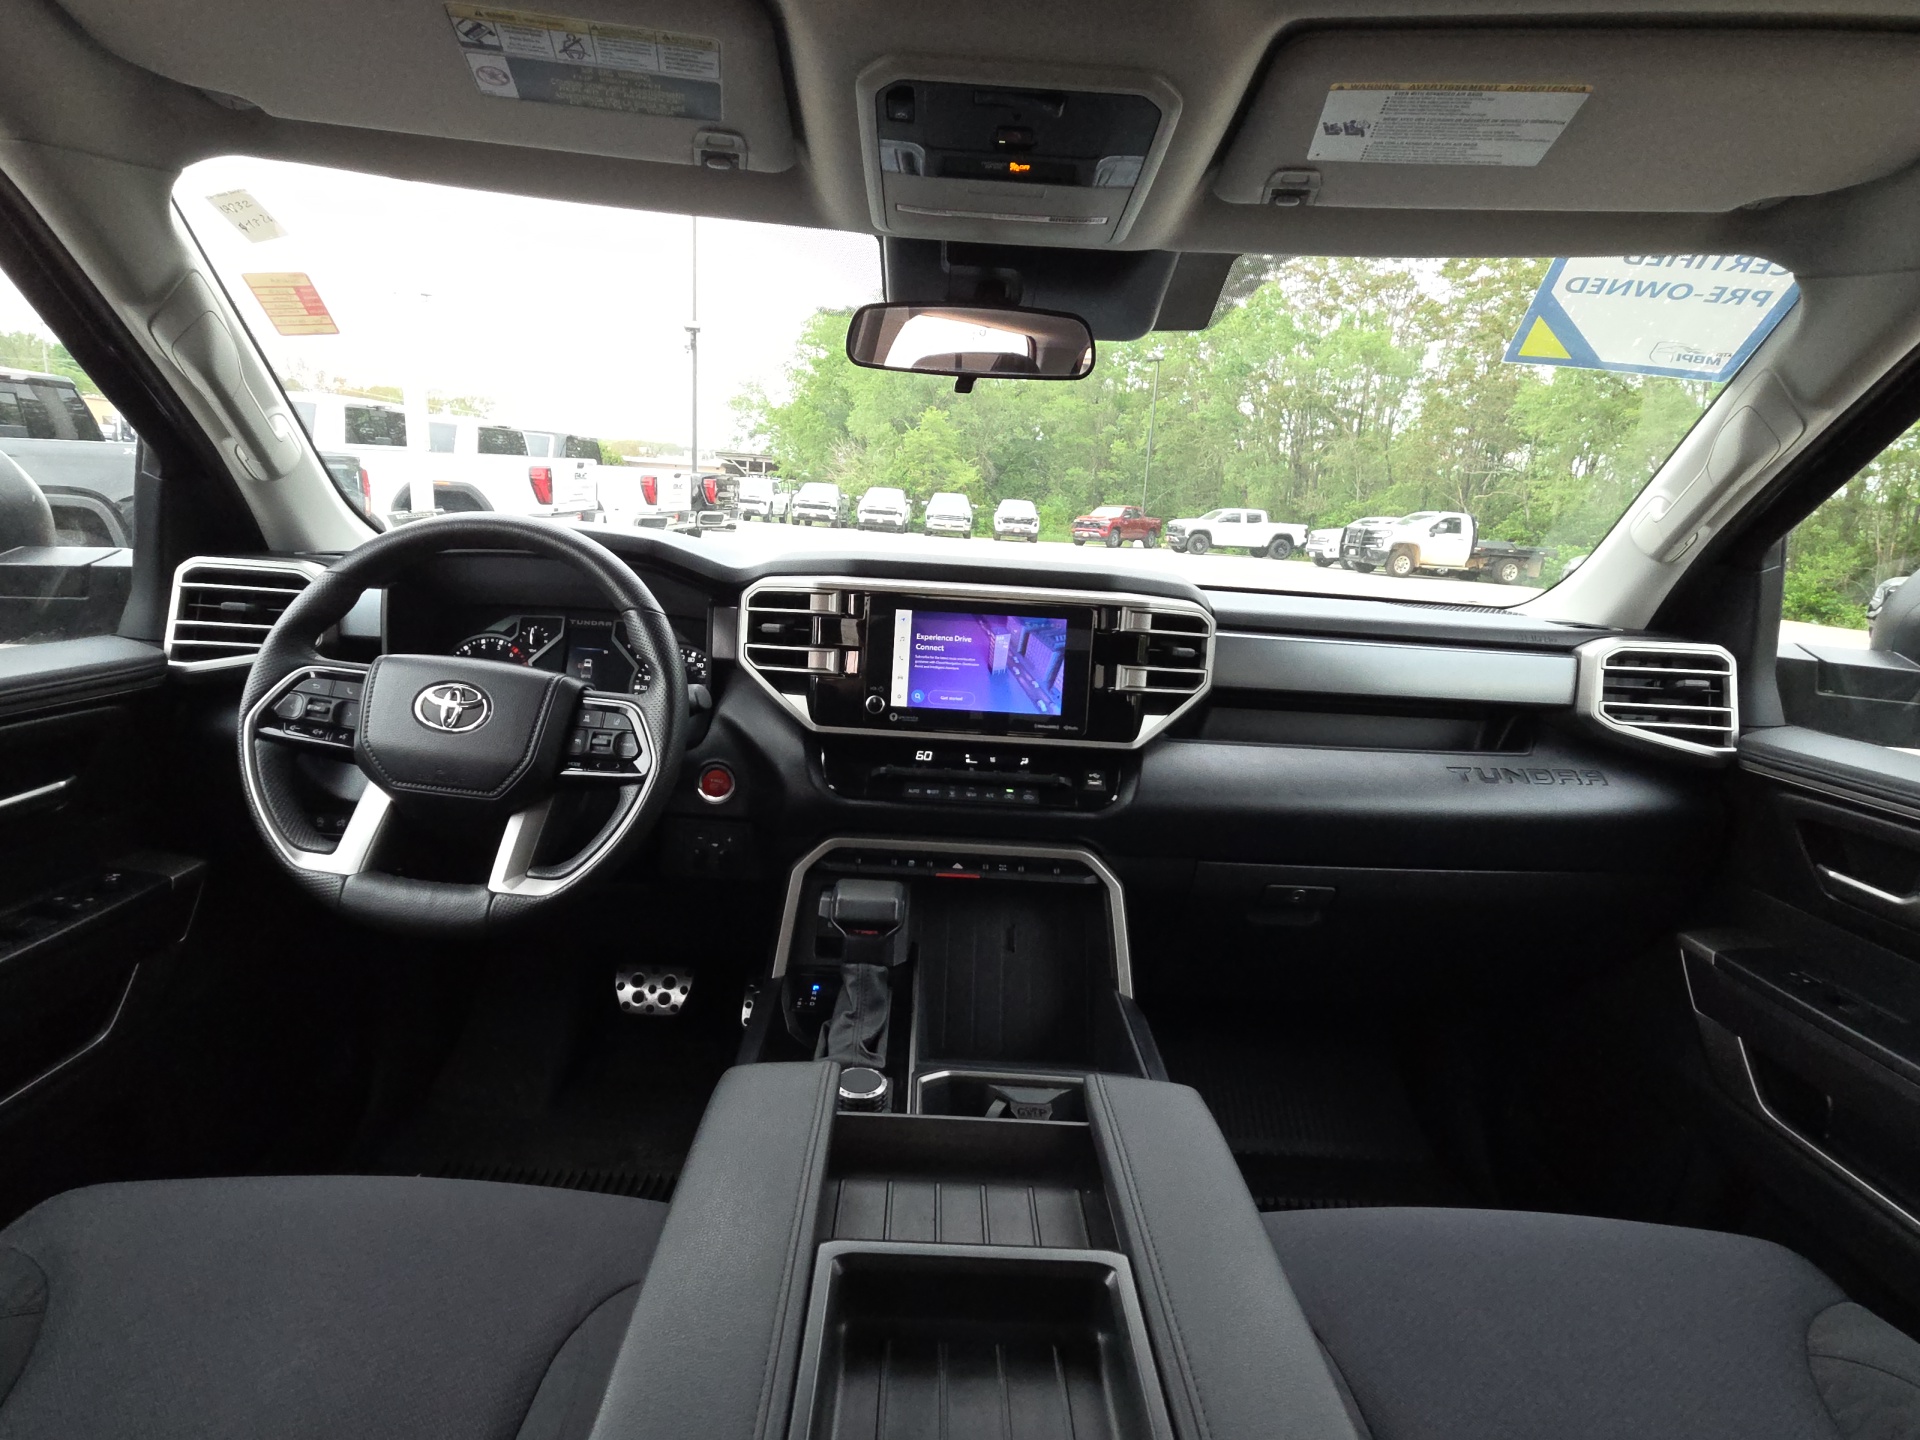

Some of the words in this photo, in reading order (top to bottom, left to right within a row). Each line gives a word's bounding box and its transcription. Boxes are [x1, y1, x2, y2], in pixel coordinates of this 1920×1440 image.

[569, 619, 612, 627] TUNDRA
[916, 633, 953, 642] Experience
[954, 635, 972, 643] Drive
[915, 643, 945, 652] Connect
[916, 751, 933, 761] 60
[1446, 766, 1609, 786] TUNDRA
